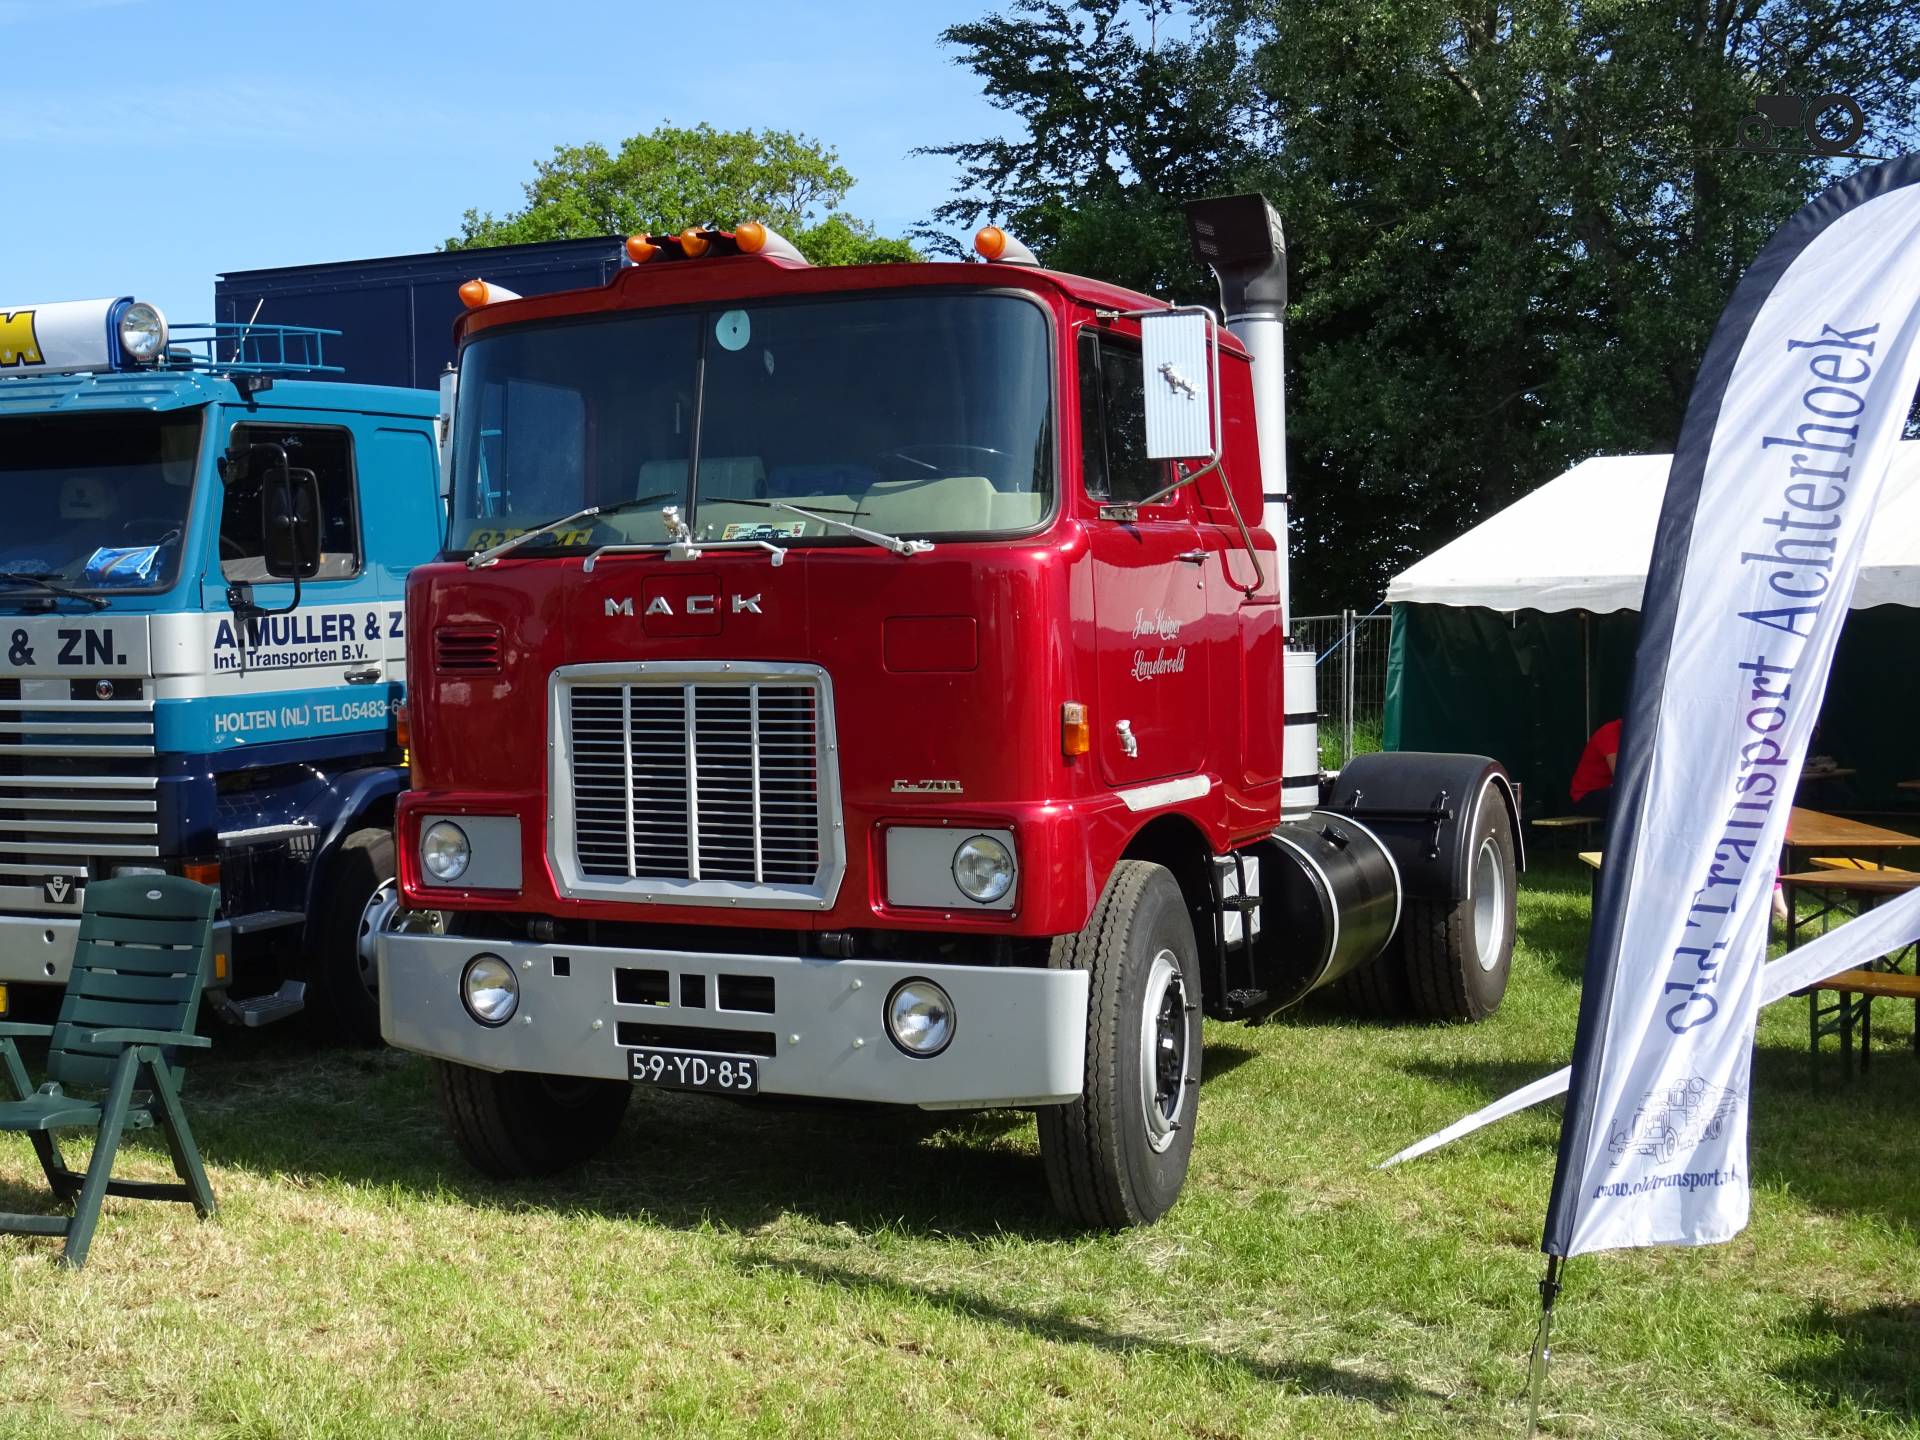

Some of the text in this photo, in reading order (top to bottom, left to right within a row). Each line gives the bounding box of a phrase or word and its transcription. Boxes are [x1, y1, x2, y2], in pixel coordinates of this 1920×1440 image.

[604, 593, 763, 617] MACK
[364, 612, 382, 640] &
[1133, 607, 1154, 639] Jan
[8, 628, 127, 666] & ZN.
[213, 643, 368, 669] Int. Transporten B.V.
[1131, 646, 1186, 682] Lemelerveld
[1665, 323, 1880, 1034] Old Transport Achterhoek
[215, 709, 276, 733] HOLTEN
[281, 706, 310, 729] (NL)
[633, 1053, 752, 1089] 59-YD-85
